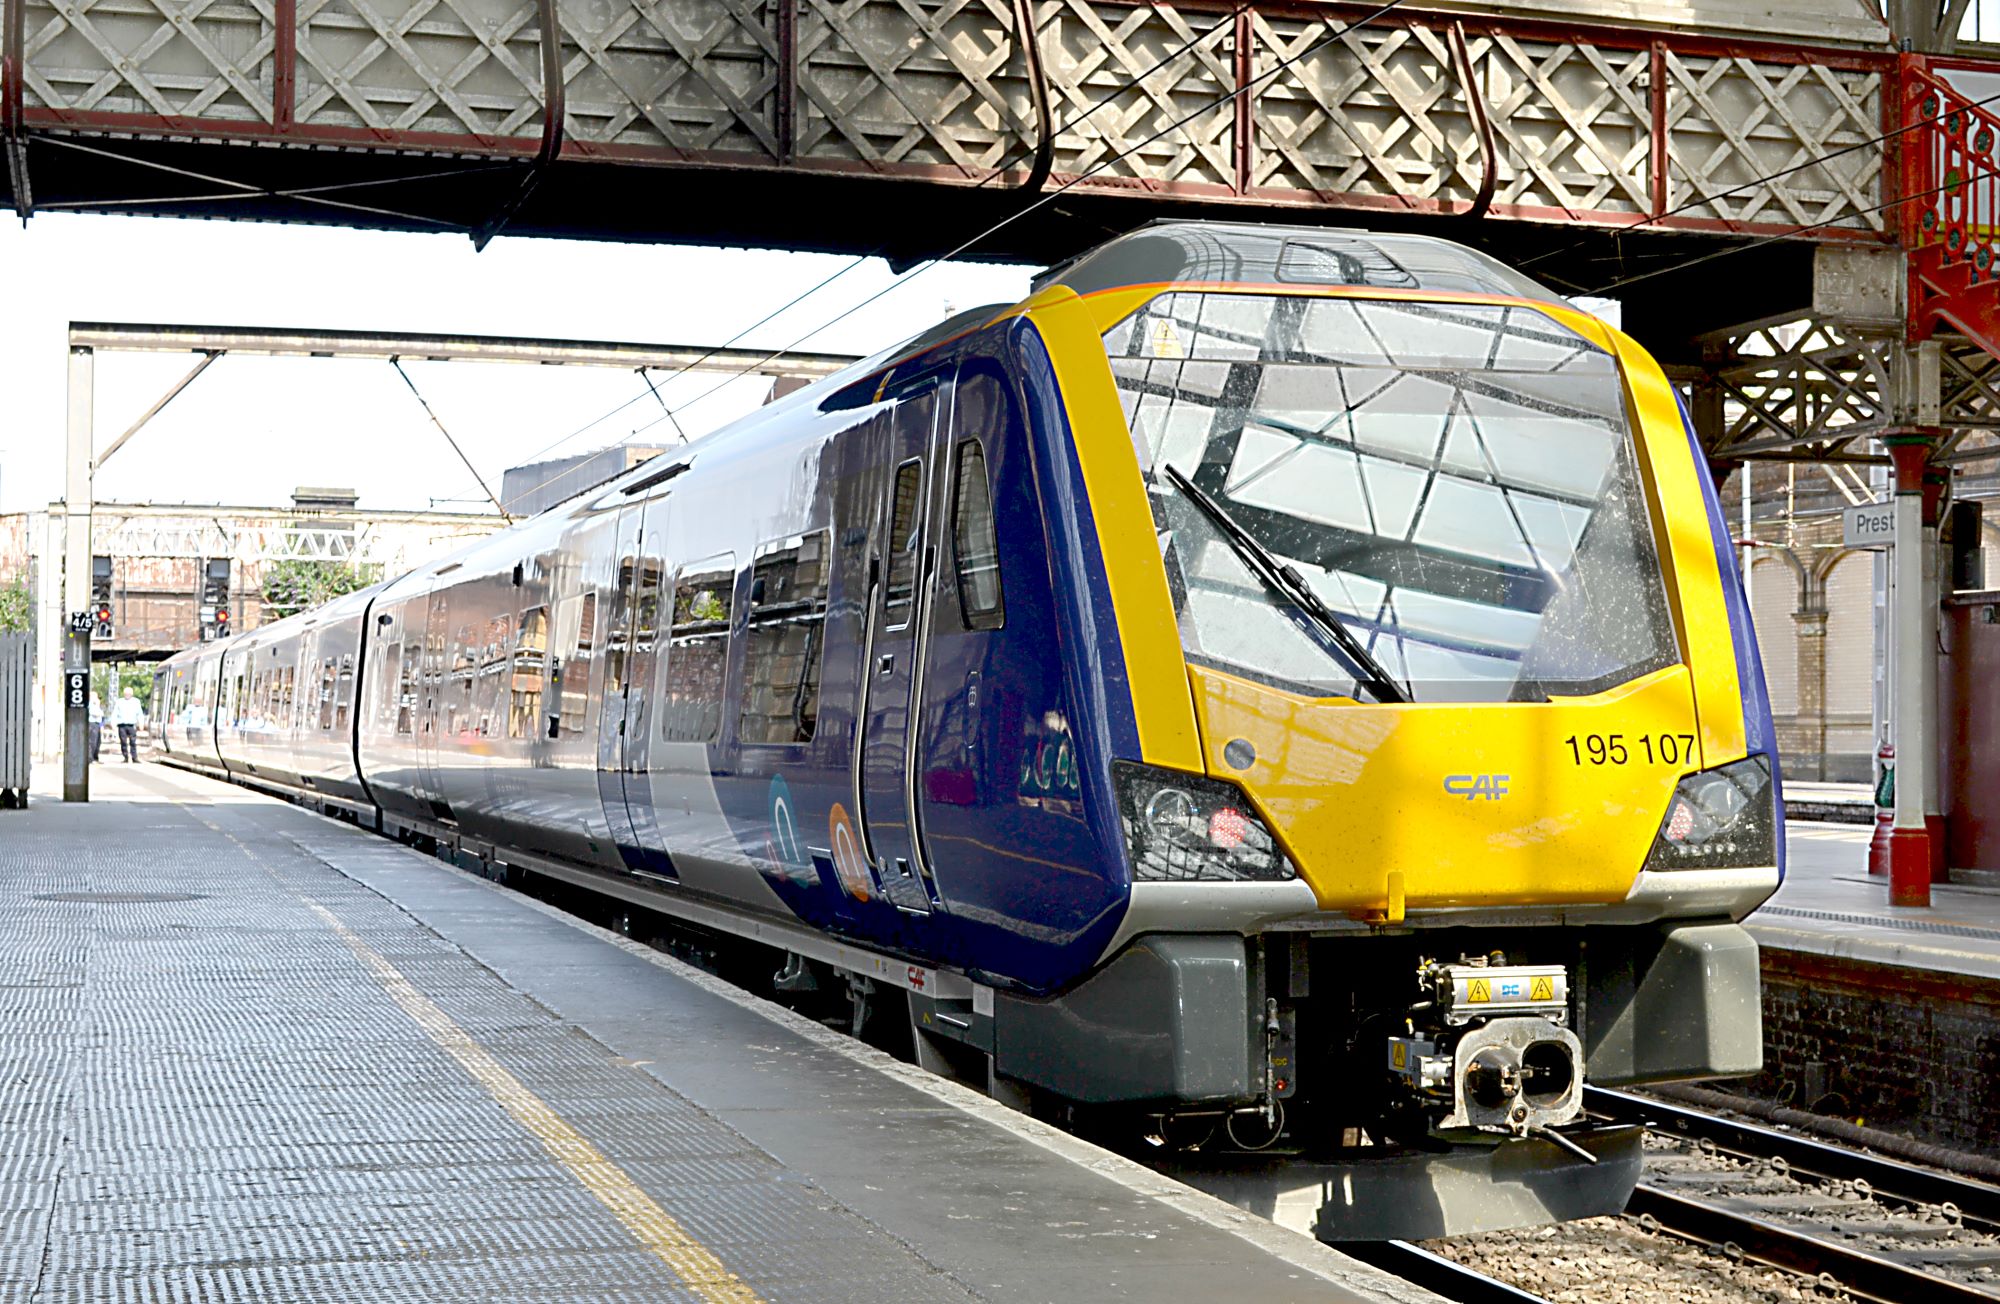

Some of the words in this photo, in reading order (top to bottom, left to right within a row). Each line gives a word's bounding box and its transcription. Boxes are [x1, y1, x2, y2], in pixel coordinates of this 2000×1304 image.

[1857, 512, 1895, 534] Prest
[72, 617, 93, 629] 4/5
[71, 674, 83, 689] 6
[71, 689, 84, 704] 8
[1565, 734, 1628, 766] 195
[1639, 734, 1695, 764] 107
[1443, 774, 1510, 800] CAF
